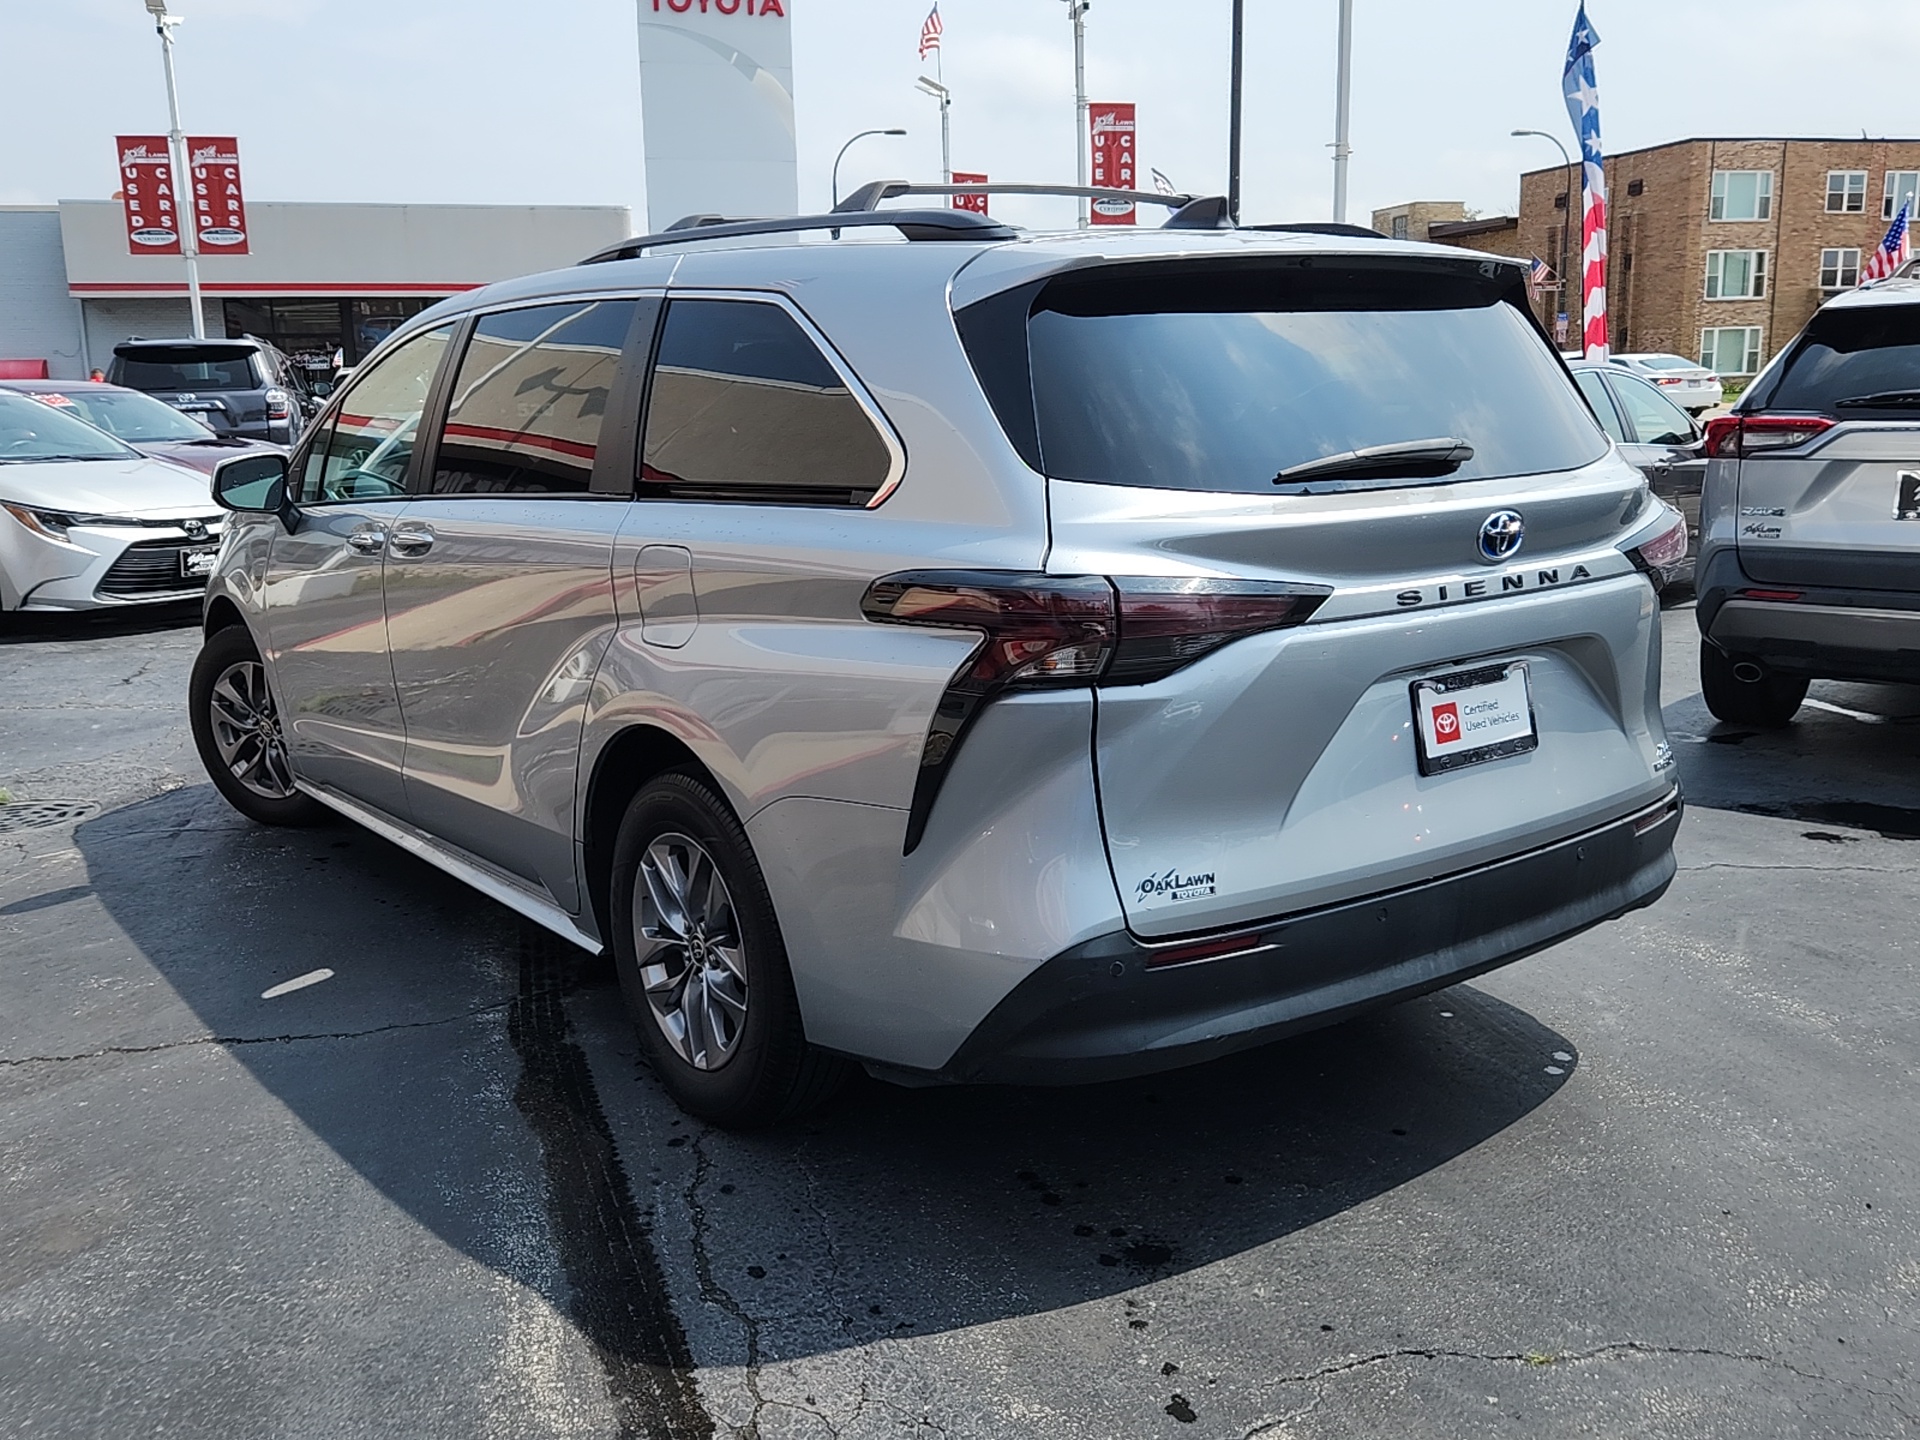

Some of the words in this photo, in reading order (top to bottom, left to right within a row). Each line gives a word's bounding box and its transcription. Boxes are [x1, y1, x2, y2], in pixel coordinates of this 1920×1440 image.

[1094, 135, 1105, 188] USE
[125, 167, 144, 227] USED
[155, 167, 172, 227] CARS
[194, 167, 213, 227] USED
[224, 167, 241, 227] CARS
[1397, 564, 1591, 606] SIENNA
[1463, 699, 1500, 716] Certified
[1465, 718, 1488, 732] Used
[1488, 711, 1521, 727] Vehicles
[1176, 887, 1211, 899] TOYOTA
